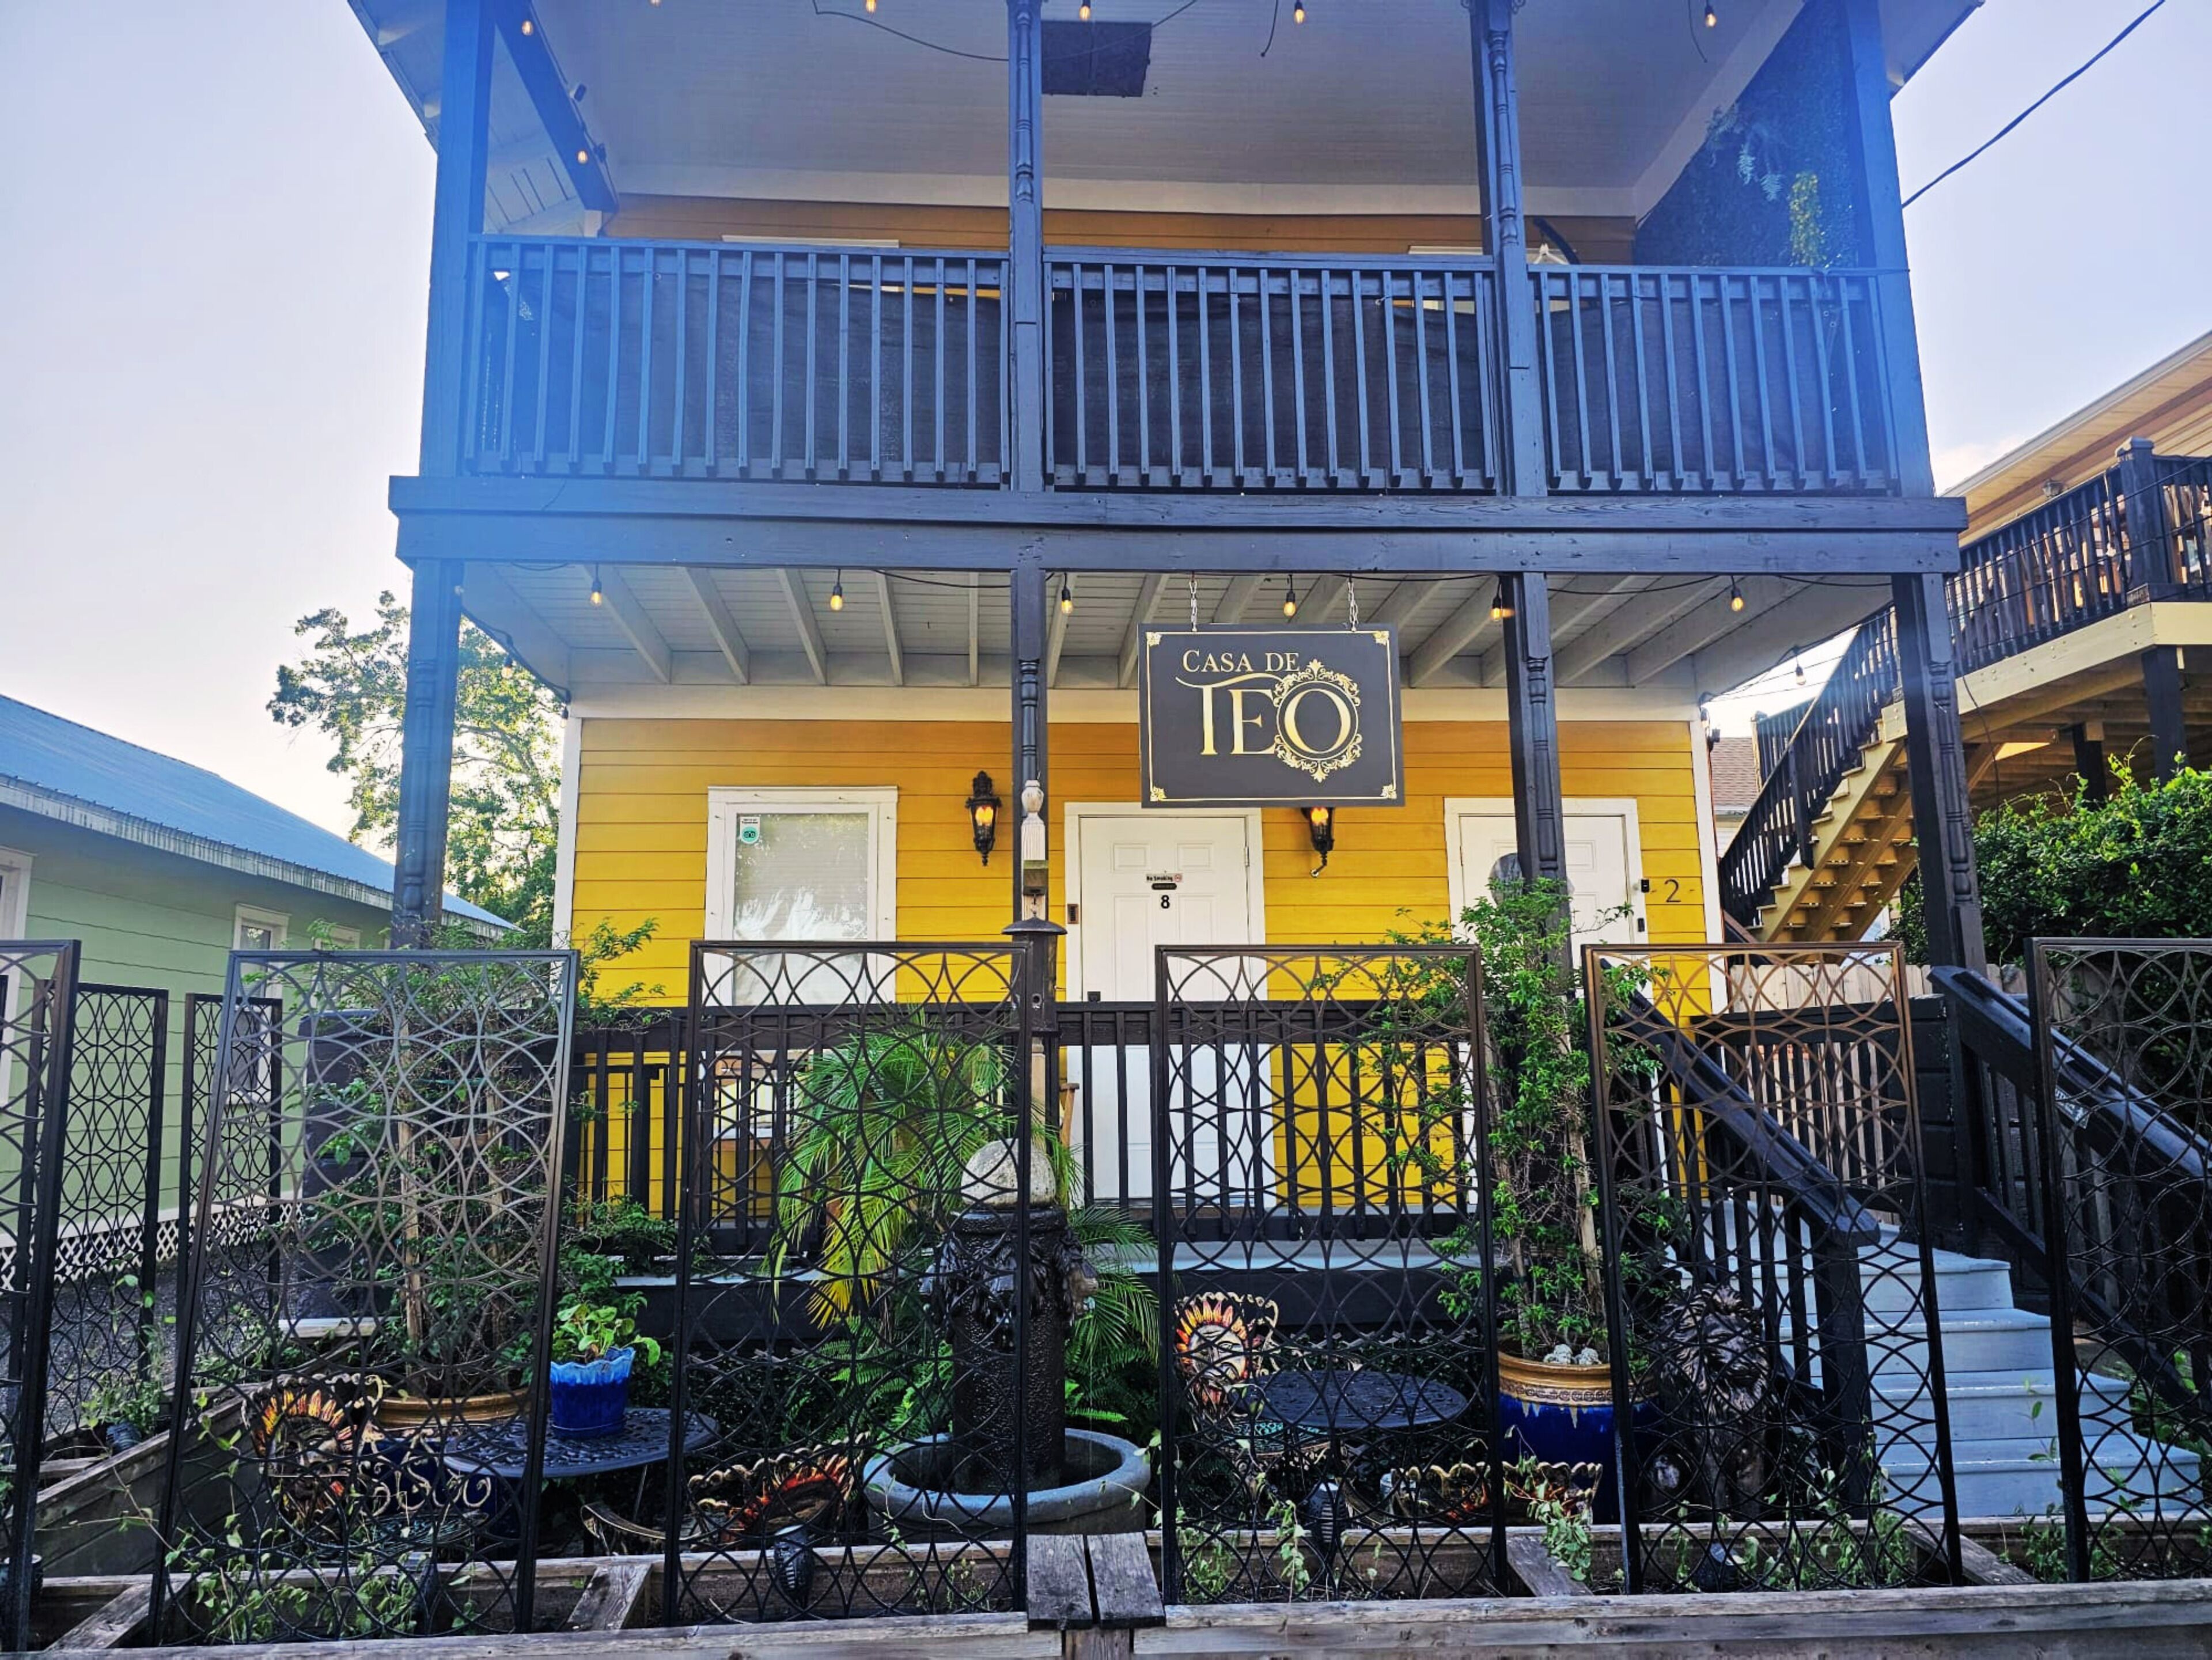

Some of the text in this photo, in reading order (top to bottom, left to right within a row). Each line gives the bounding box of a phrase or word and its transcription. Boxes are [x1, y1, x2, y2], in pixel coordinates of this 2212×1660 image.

[1183, 649, 1300, 673] CASA DE
[1175, 672, 1351, 756] TEO
[1161, 895, 1170, 909] 8
[1664, 879, 1681, 903] 2
